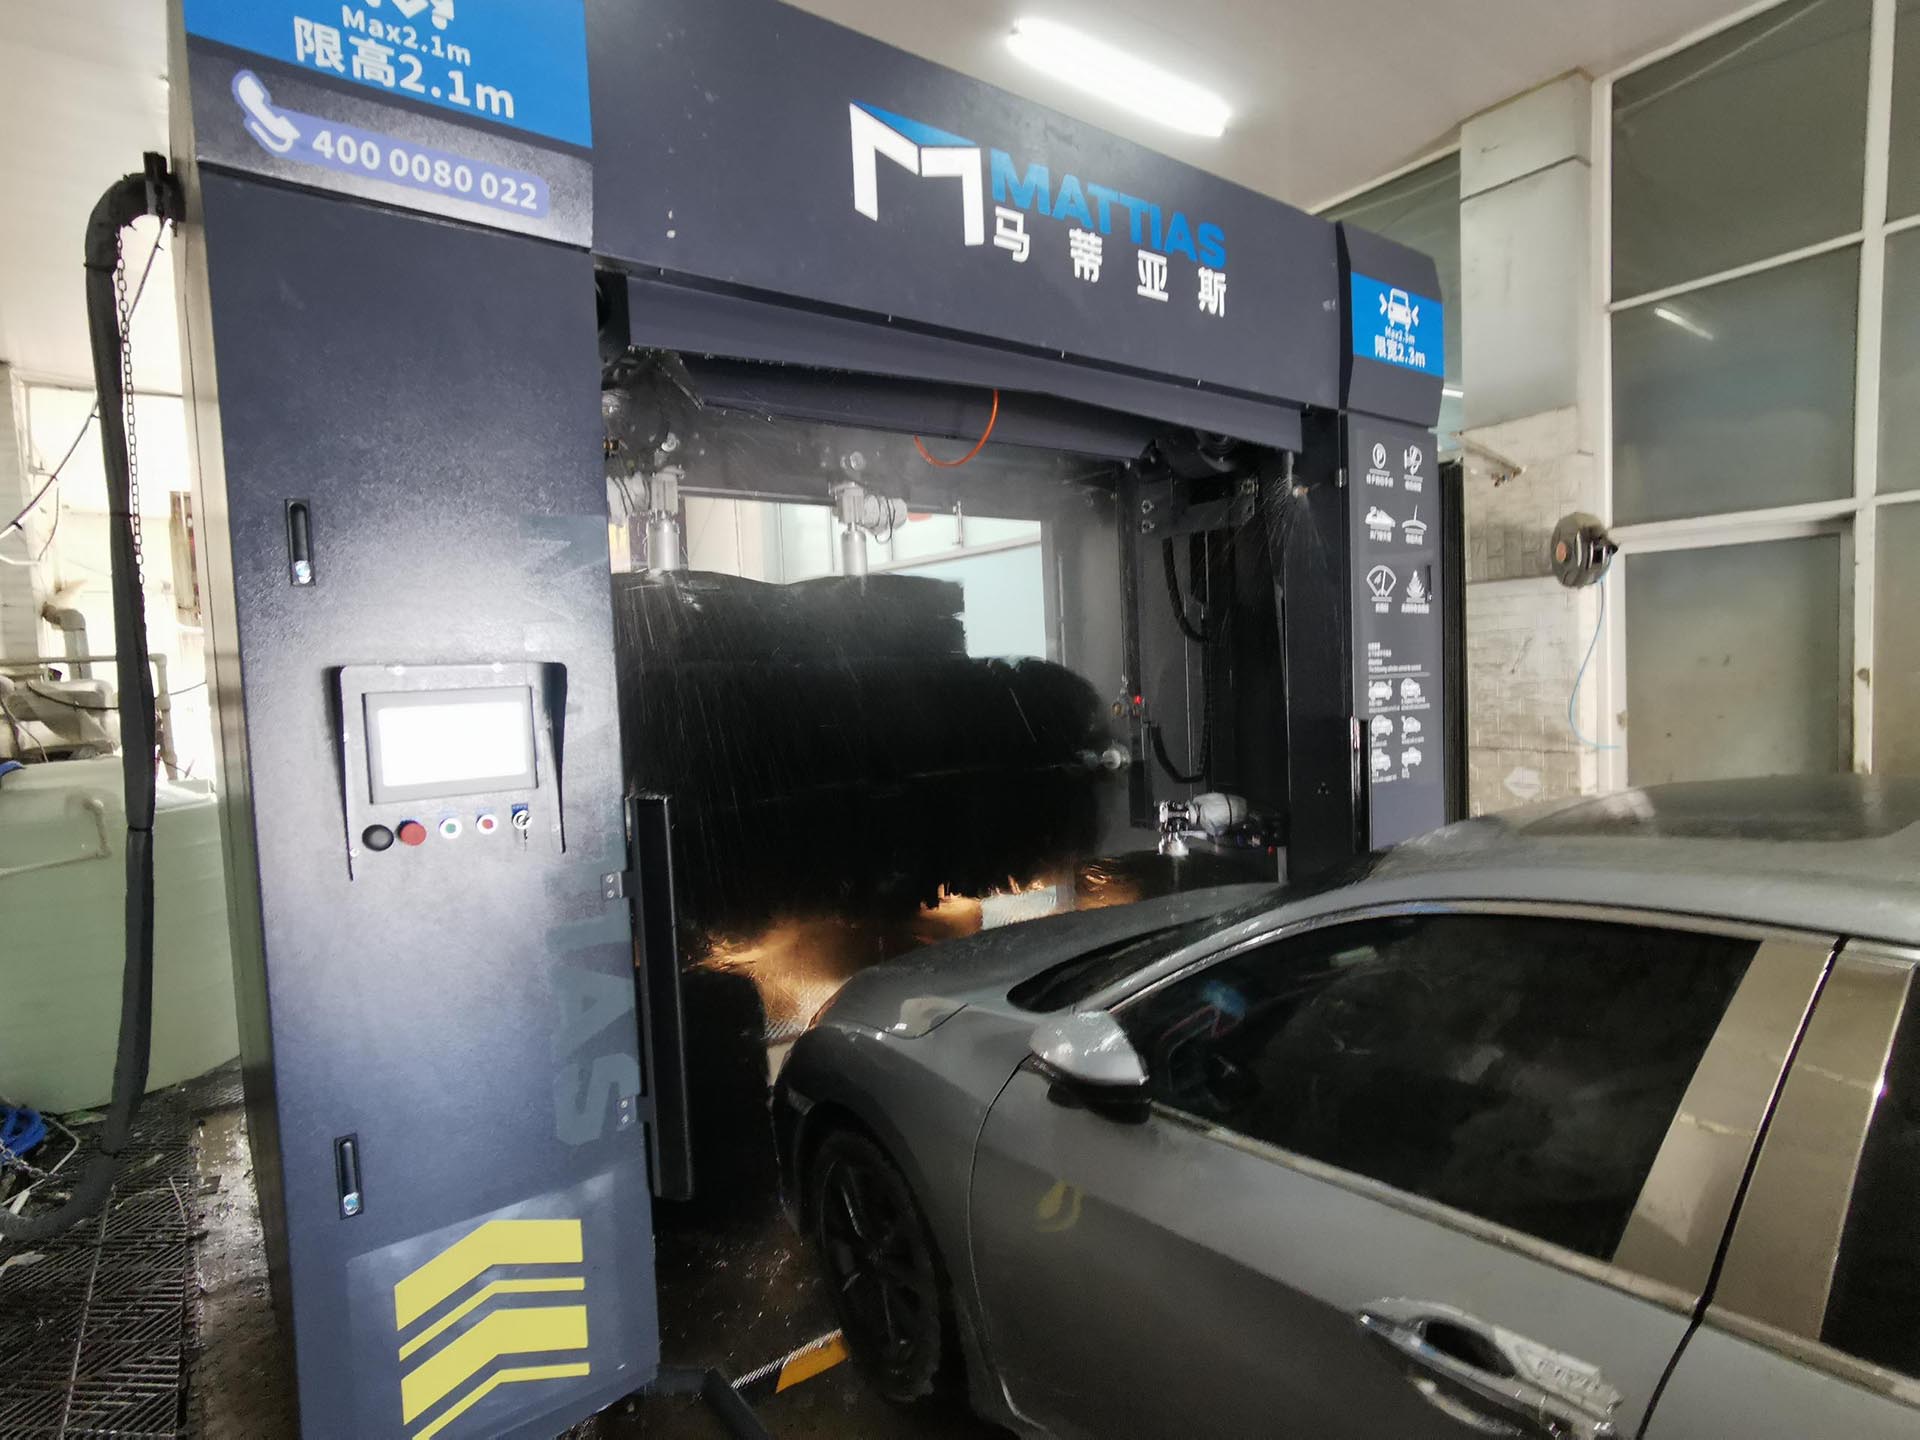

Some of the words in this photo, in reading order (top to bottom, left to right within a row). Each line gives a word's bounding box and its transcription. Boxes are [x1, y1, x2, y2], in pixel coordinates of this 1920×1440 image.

[294, 16, 514, 118] 限高2.1m
[342, 5, 471, 66] Max2.1m
[312, 130, 380, 171] 400
[389, 149, 472, 193] 0080
[480, 171, 538, 210] 022
[990, 147, 1227, 268] MATTIAS
[993, 205, 1227, 317] 马蒂亚斯
